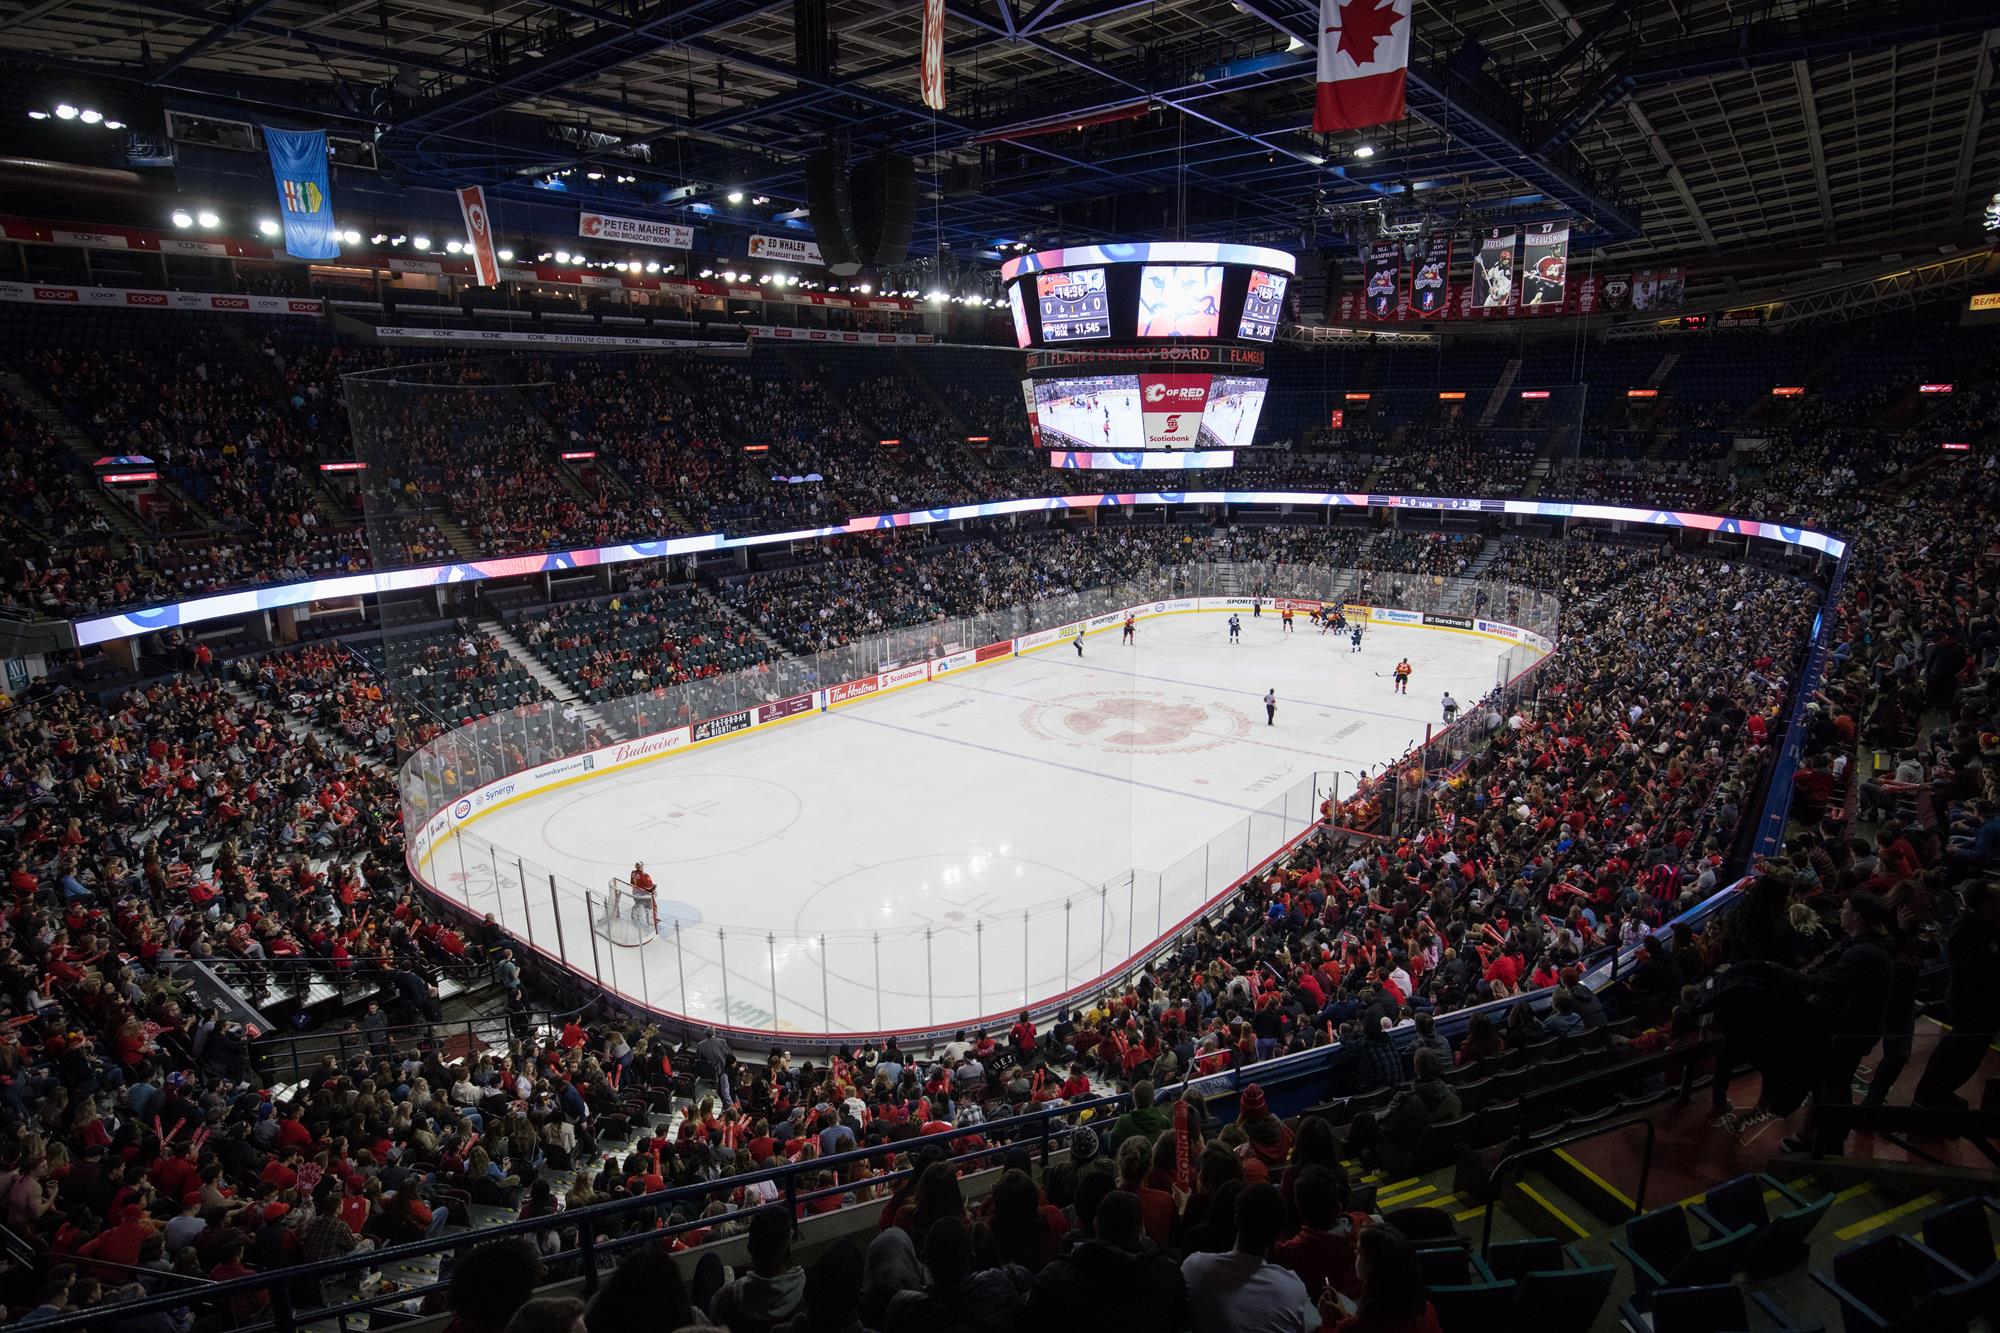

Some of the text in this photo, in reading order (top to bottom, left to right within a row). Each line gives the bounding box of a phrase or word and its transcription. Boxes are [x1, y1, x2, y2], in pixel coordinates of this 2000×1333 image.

[604, 219, 636, 232] PETER
[638, 224, 670, 236] MAHER
[1542, 224, 1554, 234] 17
[604, 230, 620, 238] RADIO
[621, 232, 652, 242] BROADCAST
[652, 236, 670, 244] BOOTH
[1493, 229, 1498, 238] 9
[1530, 233, 1562, 244] KELUSKY
[768, 239, 805, 252] ED WHALEN
[1488, 240, 1504, 249] TOTH
[766, 250, 790, 260] BROADCAST
[1370, 251, 1398, 260] HAMPIONS
[38, 290, 73, 298] CO-OP
[1058, 285, 1084, 298] 14:36
[131, 295, 162, 303] CO-OP
[1046, 302, 1052, 314] 0
[1094, 298, 1100, 310] 0
[380, 328, 404, 336] ICONIC
[1074, 322, 1100, 335] $1,545
[555, 335, 594, 343] PLATINUM
[1051, 347, 1210, 364] FLAMES ENERGY BOARD
[1166, 388, 1180, 396] OF
[1180, 387, 1205, 398] RED
[1150, 434, 1190, 442] Scotiabank
[1435, 617, 1464, 626] Sandman
[1487, 628, 1518, 638] SUPERSTORE
[8, 660, 26, 680] AVI
[890, 670, 924, 682] Scotiabank
[832, 682, 878, 702] Tim Hortons
[710, 713, 746, 728] SATURDAY
[712, 725, 732, 736] NIGHT!
[613, 736, 679, 762] Budweiser
[486, 784, 514, 800] Synergy
[1177, 1130, 1188, 1180] DINOS
